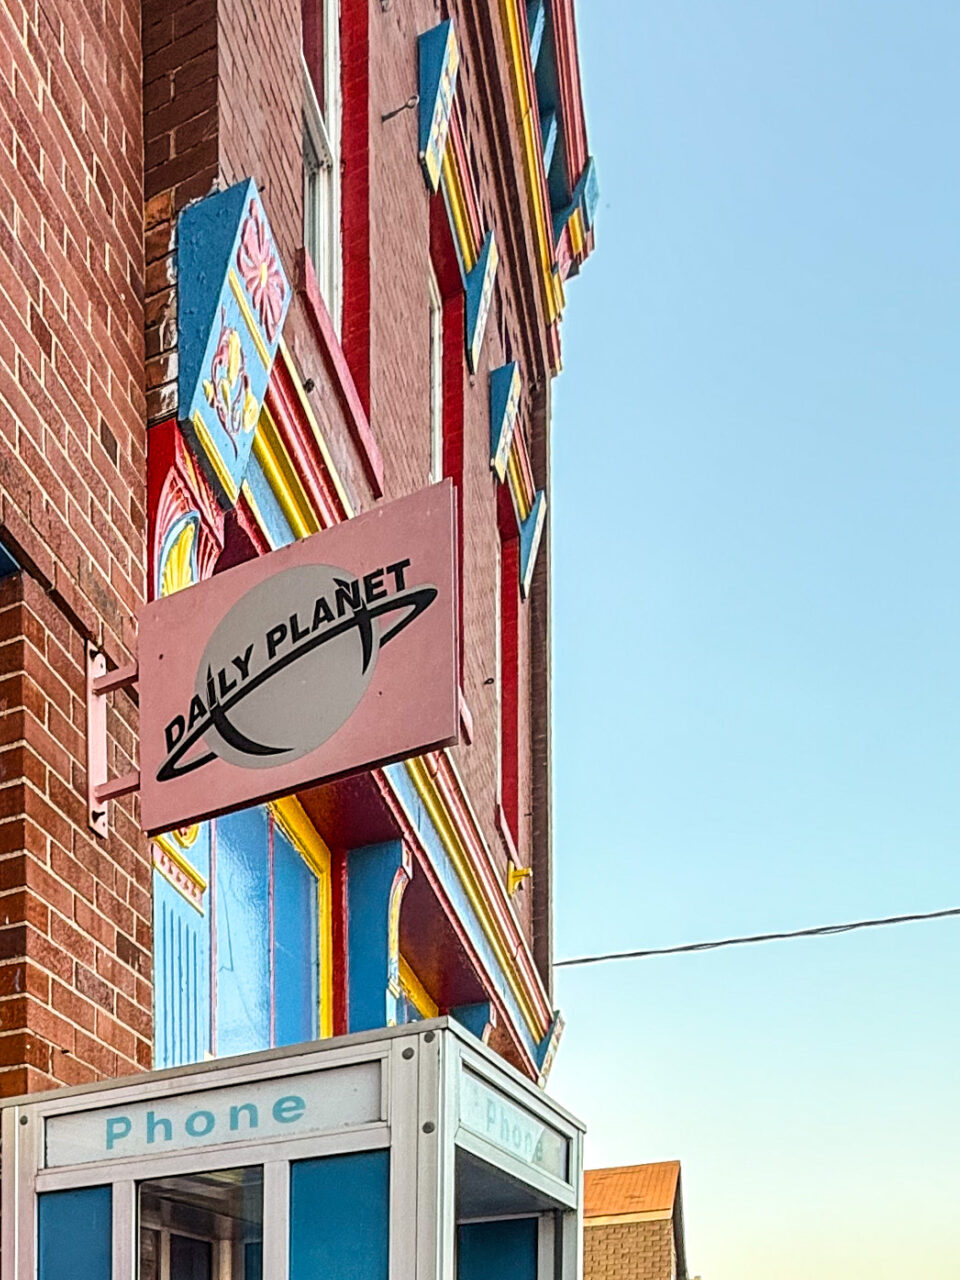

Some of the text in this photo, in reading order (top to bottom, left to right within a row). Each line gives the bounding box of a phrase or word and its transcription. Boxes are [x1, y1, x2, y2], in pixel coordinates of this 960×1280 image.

[164, 558, 411, 754] DAILY PLANET
[105, 1093, 307, 1150] Phone
